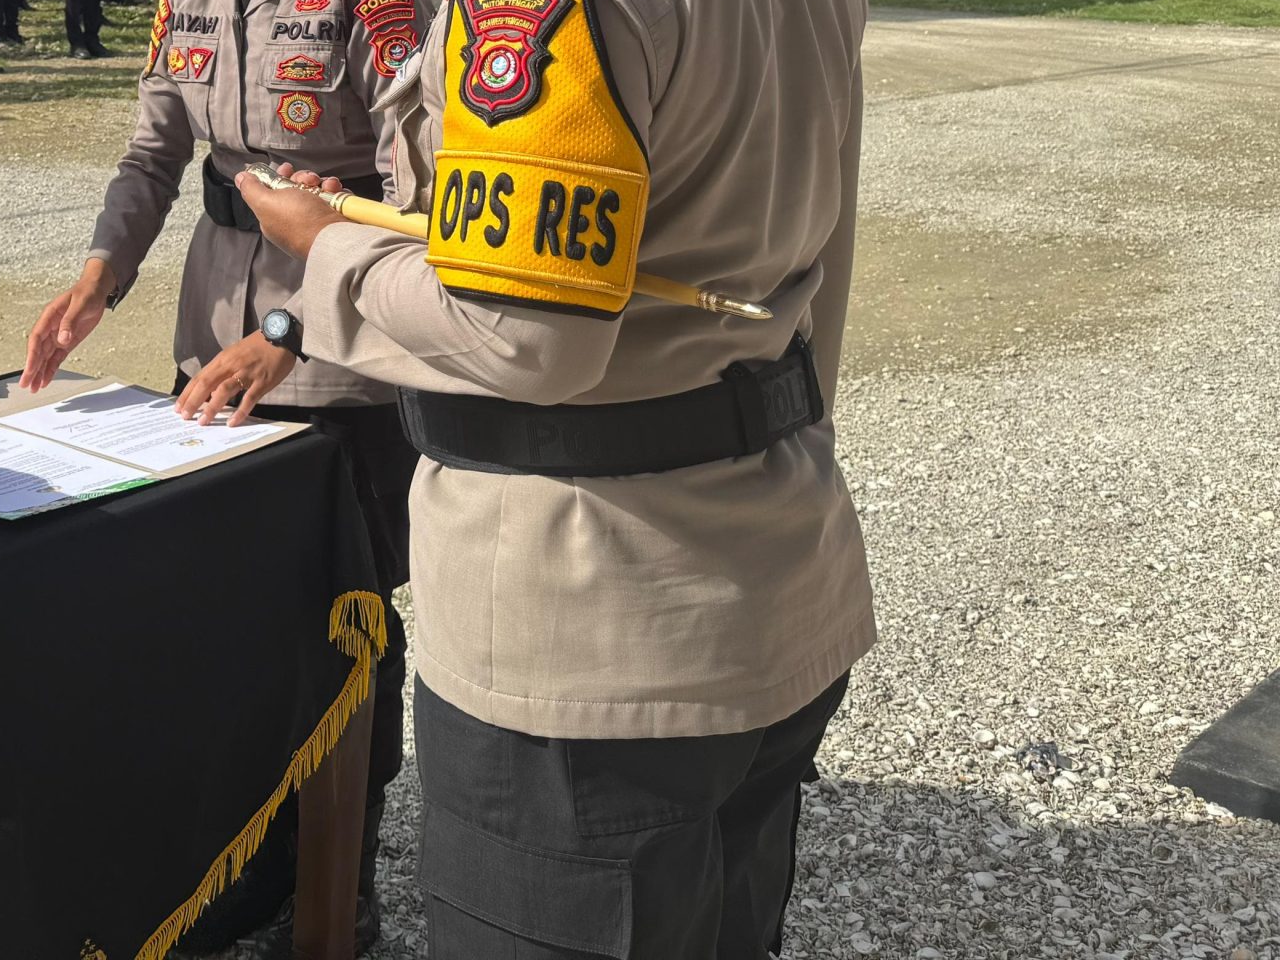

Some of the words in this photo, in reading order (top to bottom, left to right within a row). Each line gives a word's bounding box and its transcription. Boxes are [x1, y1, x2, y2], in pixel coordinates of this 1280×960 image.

[508, 0, 537, 10] TENGAH
[439, 168, 515, 249] OPS
[533, 180, 620, 267] RES
